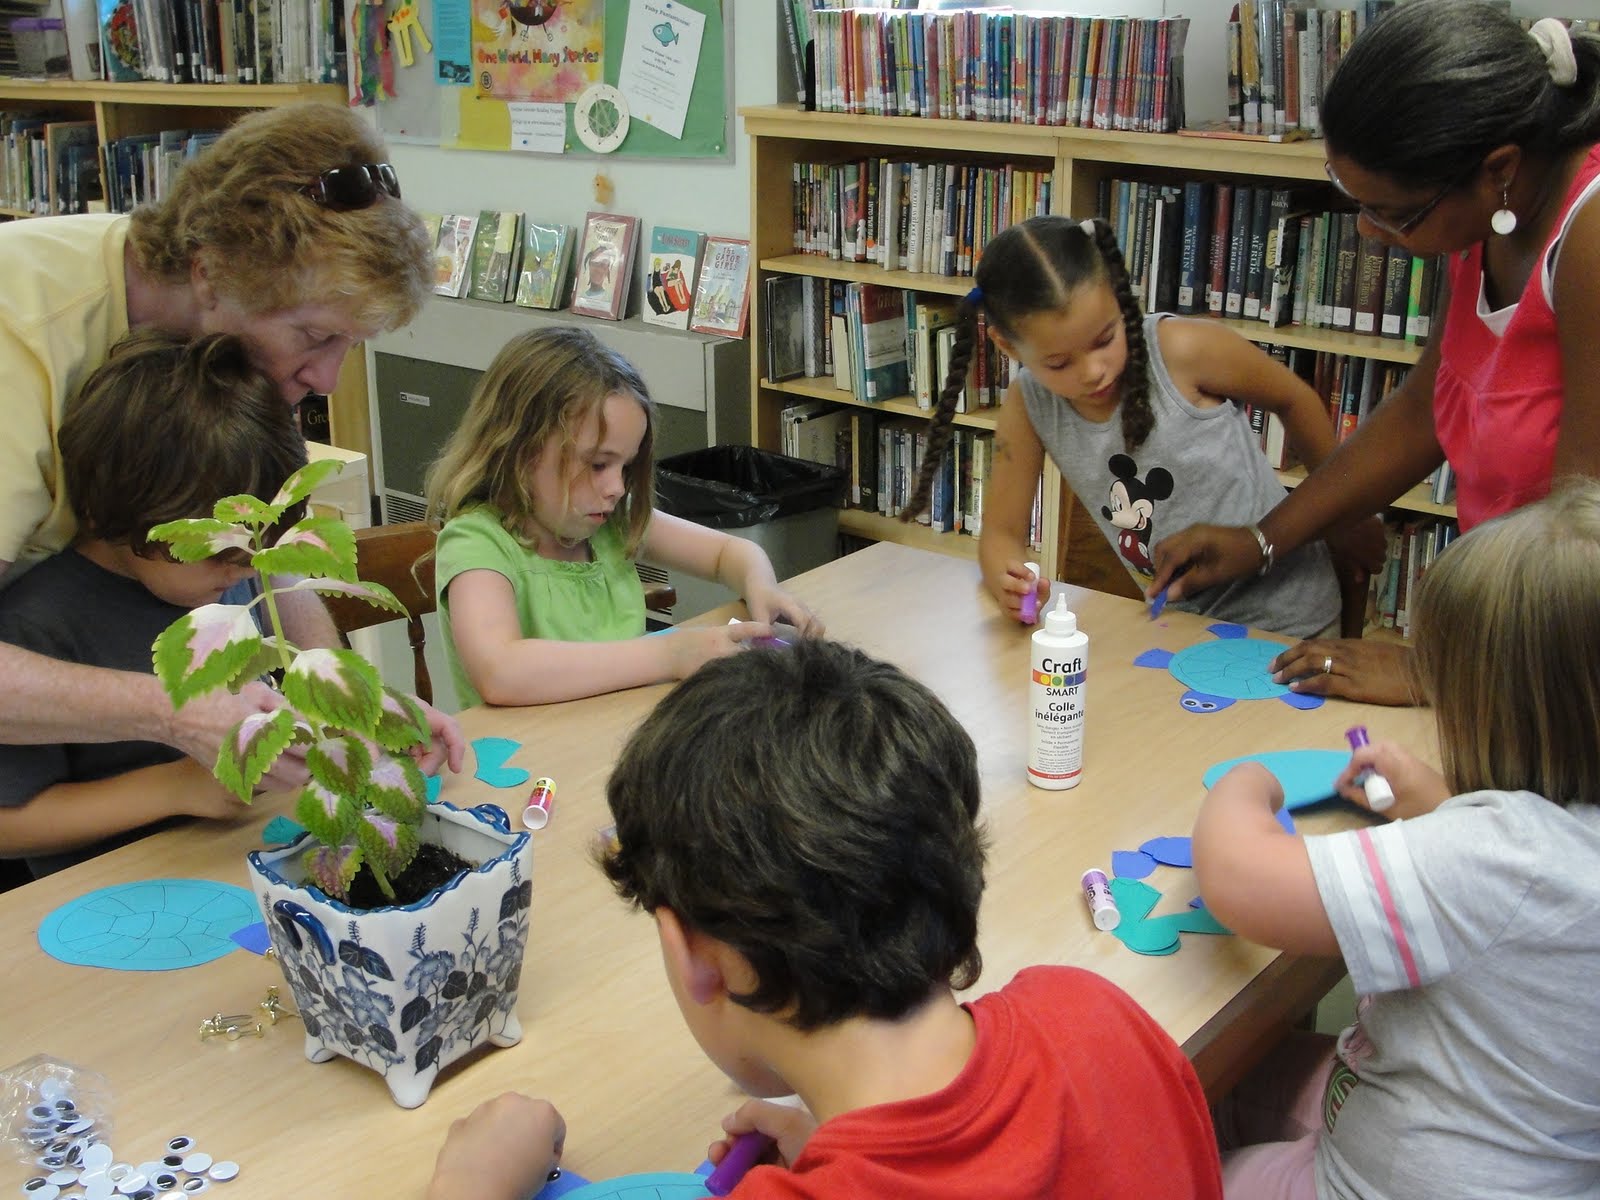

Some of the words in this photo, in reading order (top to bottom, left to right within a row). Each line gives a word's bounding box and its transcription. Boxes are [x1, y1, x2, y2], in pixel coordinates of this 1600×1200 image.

[478, 48, 497, 63] One
[498, 48, 531, 65] World,
[533, 48, 560, 67] Many
[562, 46, 599, 63] Stories
[716, 253, 740, 263] GATOR
[1184, 228, 1193, 269] MERLIN
[1231, 236, 1239, 272] MERLIN
[1250, 235, 1260, 275] MERLIN
[715, 262, 738, 270] GIRLS
[1364, 254, 1375, 282] SHADOW
[1373, 256, 1384, 277] PETER
[1396, 259, 1408, 278] PETER
[1345, 393, 1355, 414] Best
[1042, 658, 1082, 674] Craft
[1046, 686, 1079, 696] SMART
[1049, 702, 1076, 712] Colle
